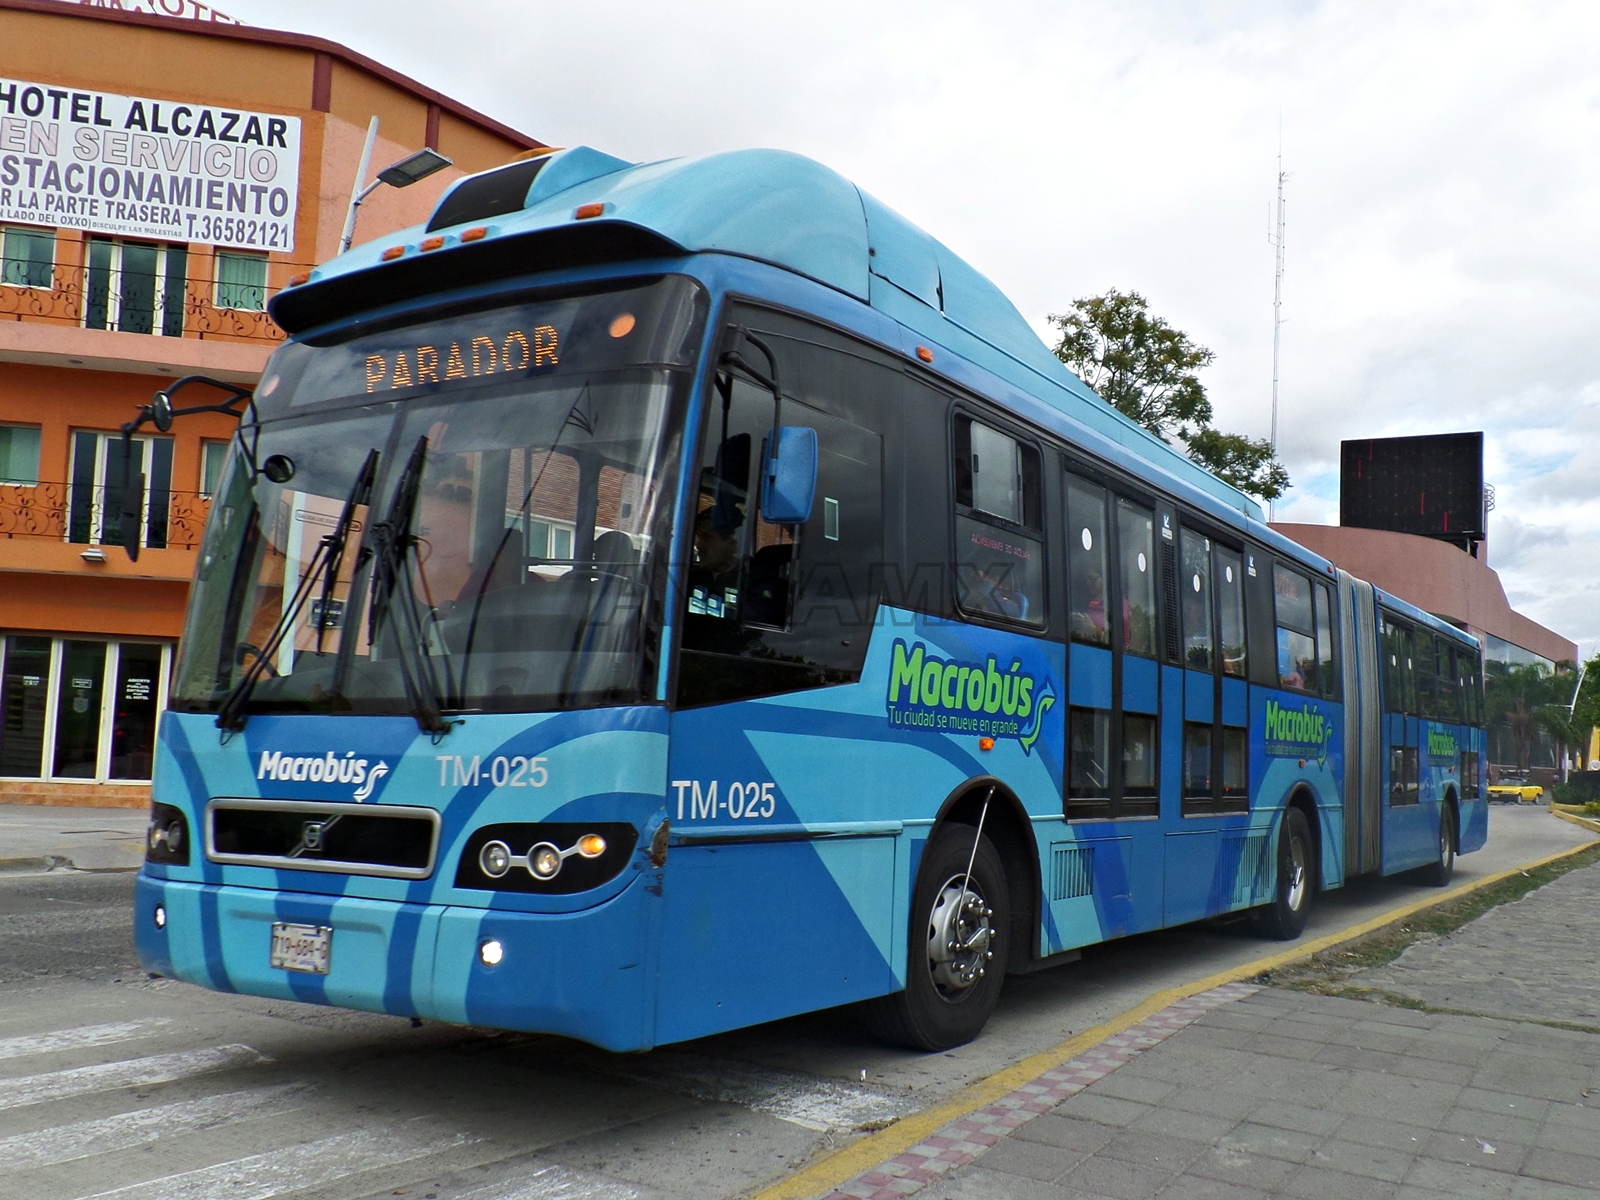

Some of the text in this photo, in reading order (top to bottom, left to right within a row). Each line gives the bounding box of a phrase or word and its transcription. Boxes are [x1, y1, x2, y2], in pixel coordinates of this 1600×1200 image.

[0, 82, 287, 148] HOTEL ALCAZAR
[0, 116, 278, 183] EN SERVICIO
[7, 209, 35, 221] LADO
[39, 213, 57, 224] DEL
[61, 216, 91, 230] OXXO)
[18, 189, 39, 210] LA
[45, 193, 99, 217] PARTE
[105, 201, 182, 226] TRASERA
[93, 221, 127, 232] DISCULPE
[144, 227, 183, 237] MOLESTIAS
[186, 213, 289, 248] T.36582121
[365, 324, 560, 394] PARADOR
[888, 643, 1034, 718] Macrobús
[888, 705, 1018, 736] Tu ciudad se mueve en grande
[1265, 700, 1324, 744] Macrobús
[257, 750, 369, 784] Macrobús
[436, 755, 549, 789] TM-025
[672, 780, 776, 819] TM-025
